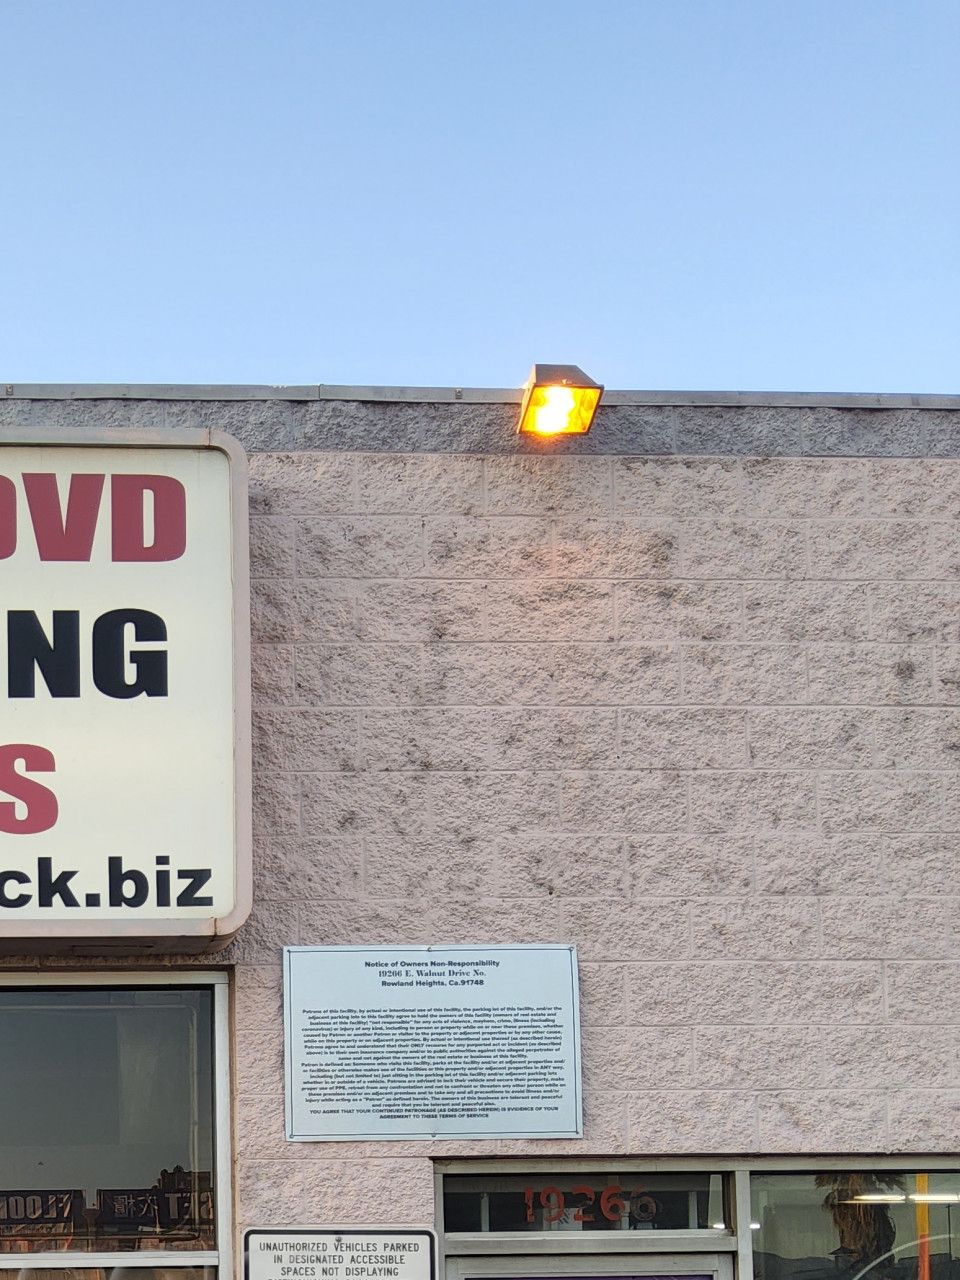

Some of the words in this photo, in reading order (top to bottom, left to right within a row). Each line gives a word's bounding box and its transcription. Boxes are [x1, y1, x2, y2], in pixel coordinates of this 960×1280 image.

[524, 1185, 658, 1223] 19266
[259, 1243, 327, 1252] UNAUTHORIZED
[334, 1243, 377, 1252] VEHICLES
[384, 1243, 419, 1252] PARKED
[274, 1255, 282, 1264] IN
[289, 1255, 344, 1264] DESIGNATED
[350, 1255, 405, 1264] ACCESSIBLE
[281, 1267, 315, 1276] SPACES
[322, 1267, 339, 1276] NOT
[346, 1267, 399, 1276] DISPLAYING
